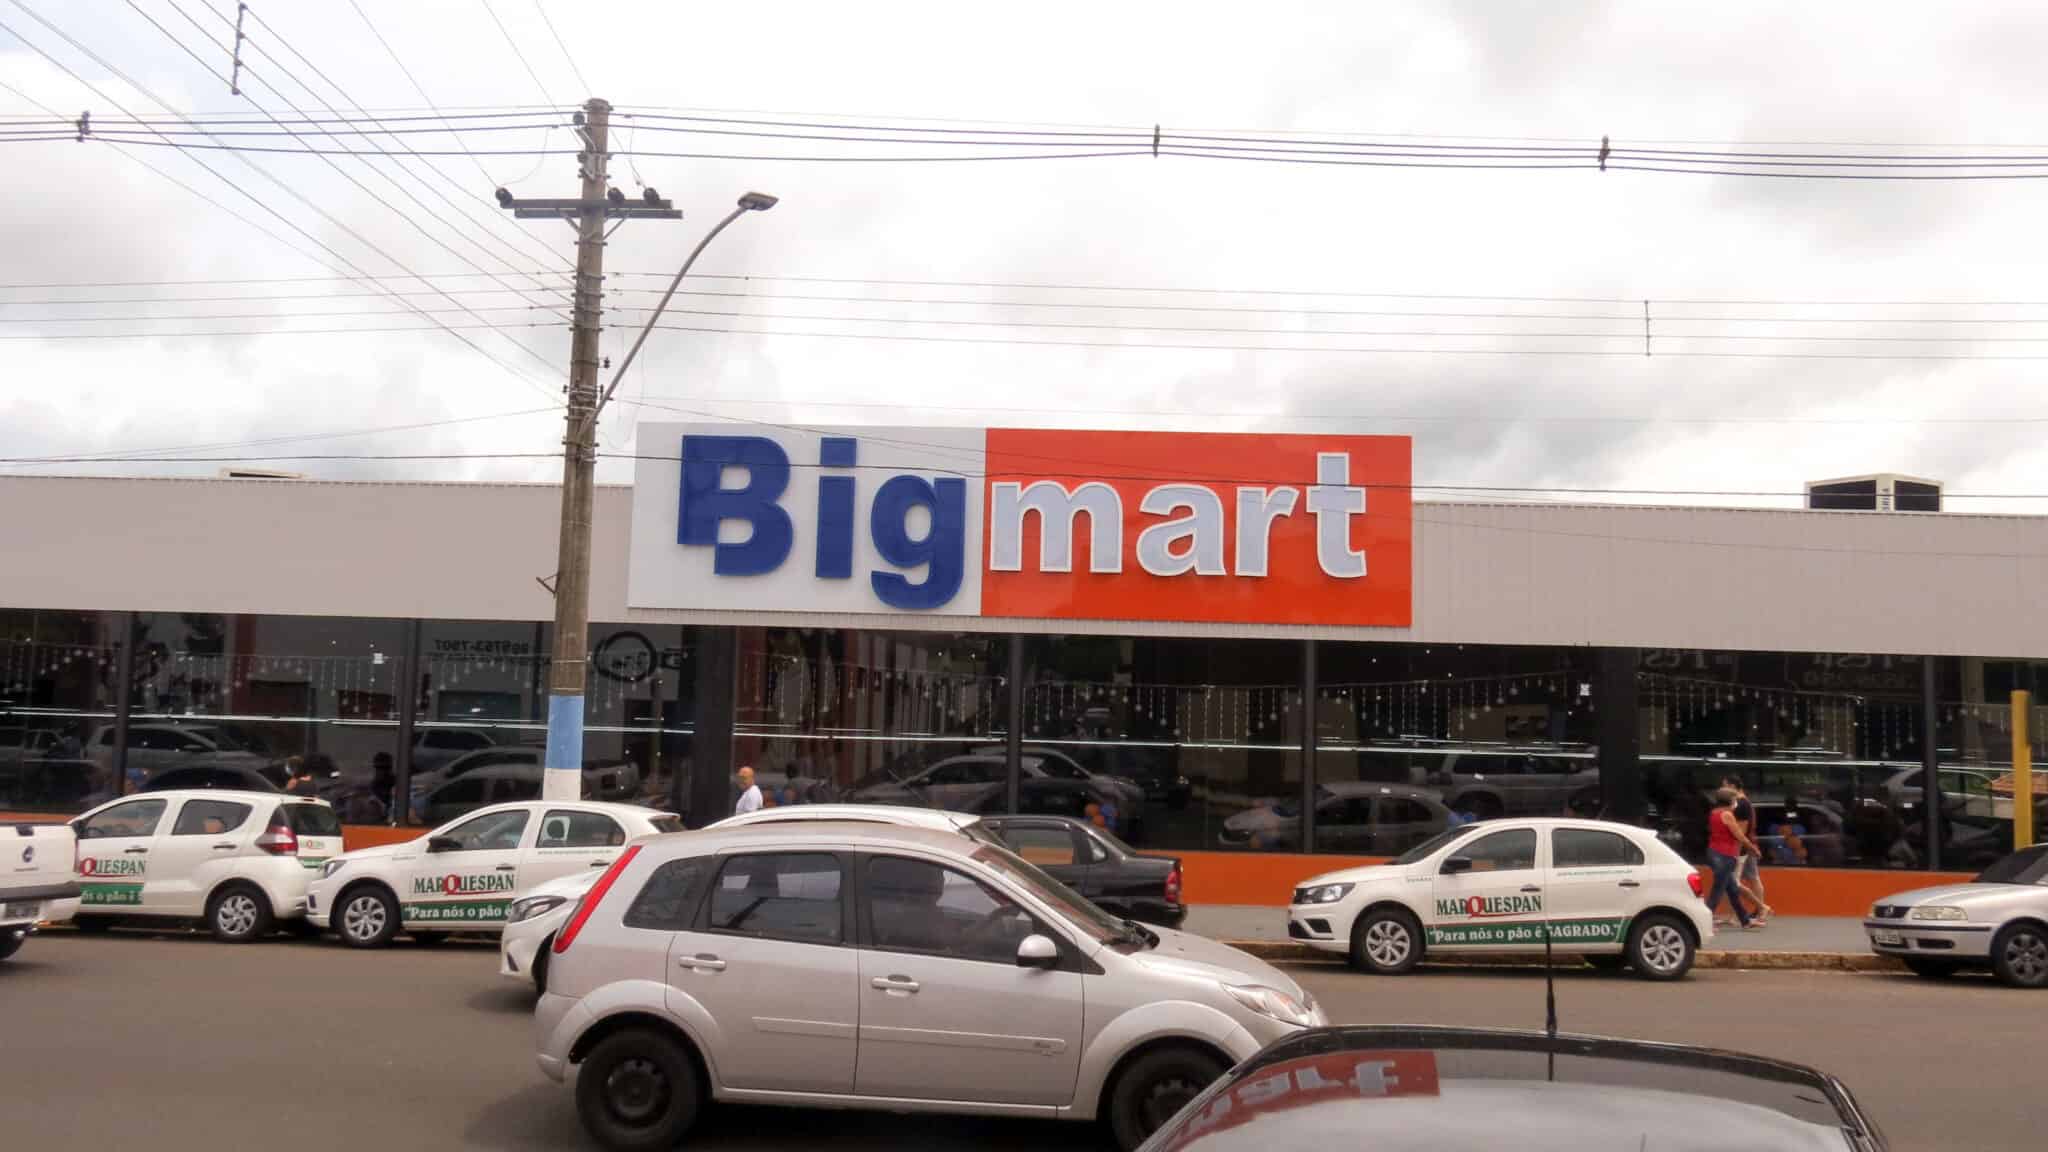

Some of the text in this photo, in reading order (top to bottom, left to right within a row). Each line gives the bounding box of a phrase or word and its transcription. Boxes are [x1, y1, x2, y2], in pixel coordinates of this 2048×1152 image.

[80, 857, 145, 877] QUESPAN
[414, 874, 515, 895] MARQUESPAN
[442, 905, 464, 917] nós
[467, 908, 476, 916] o
[480, 905, 502, 918] pão
[1436, 896, 1542, 918] MARQUESPAN
[1469, 928, 1493, 940] nós
[1507, 927, 1532, 940] pão
[1534, 926, 1542, 938] é
